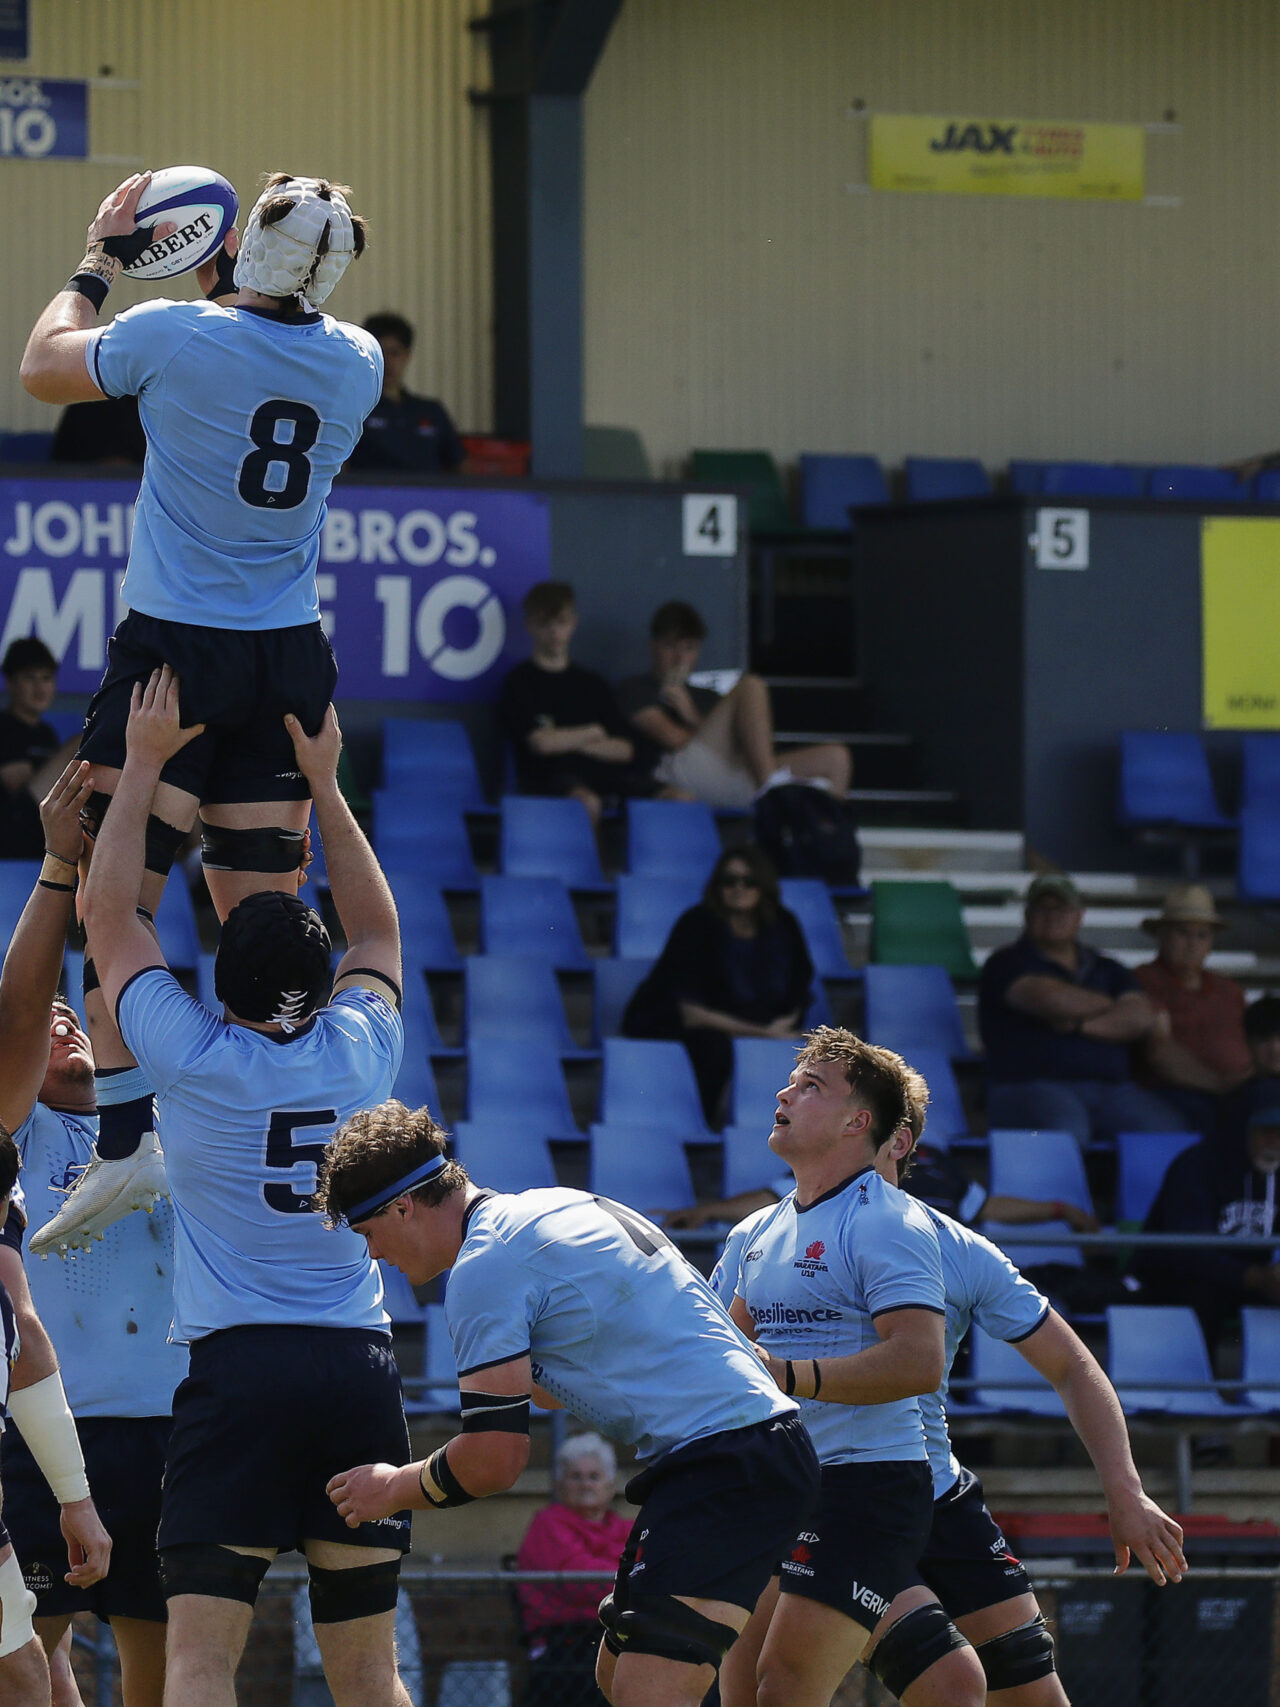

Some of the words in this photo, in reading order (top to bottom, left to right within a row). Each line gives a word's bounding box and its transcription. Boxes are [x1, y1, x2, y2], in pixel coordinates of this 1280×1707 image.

[930, 121, 1016, 155] JAX
[235, 398, 324, 511] 8
[322, 508, 497, 568] BROS.
[697, 506, 722, 545] 4
[1052, 518, 1076, 560] 5
[375, 574, 506, 682] 10
[259, 1107, 337, 1214] 5
[750, 1302, 843, 1324] Resilience
